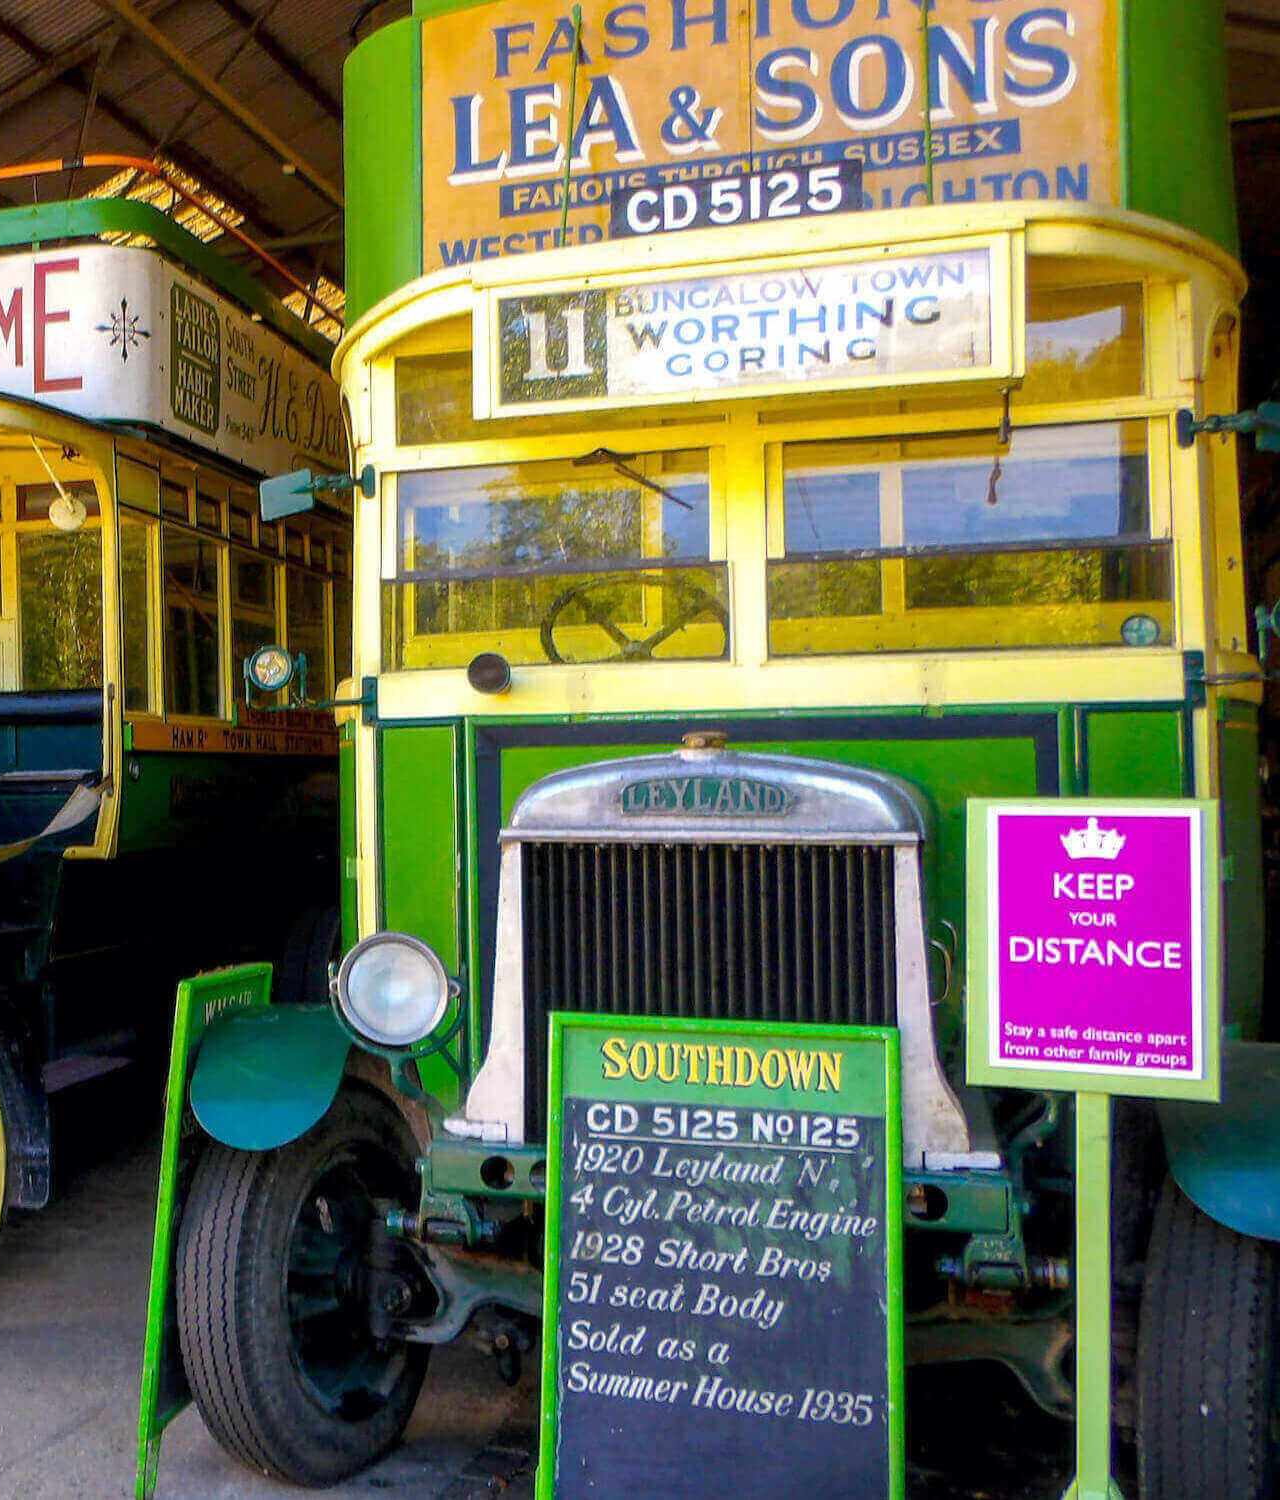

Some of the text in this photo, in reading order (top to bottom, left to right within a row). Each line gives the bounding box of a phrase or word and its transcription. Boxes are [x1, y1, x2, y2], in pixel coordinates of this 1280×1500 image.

[447, 8, 1078, 186] LEA & SONS
[843, 125, 1004, 166] SUSSEX
[626, 165, 842, 234] CD 5125
[615, 277, 824, 319] BUNGALOW
[626, 295, 943, 351] WORTHING
[226, 355, 256, 402] STREET
[665, 337, 879, 377] GORING
[174, 385, 215, 430] MAKER
[628, 782, 786, 813] LEYLAND
[1052, 872, 1135, 900] KEEP
[1070, 912, 1117, 927] YOUR
[1008, 936, 1182, 969] DISTANCE
[1004, 1042, 1188, 1067] from other family groups
[1005, 1021, 1187, 1046] Stay a safe distance apart
[602, 1037, 842, 1091] SOUTHDOWN
[587, 1103, 639, 1134] CD
[652, 1108, 738, 1140] 5125
[574, 1142, 644, 1176] 1920
[651, 1147, 784, 1188] Leyland
[570, 1183, 878, 1241] 4 Cyl. Petrol Engine
[570, 1230, 645, 1266] 1928
[654, 1238, 747, 1274] Short
[568, 1272, 785, 1330] 51 seat Body
[568, 1320, 731, 1366] Sold as a
[567, 1361, 874, 1427] Summer House 1935
